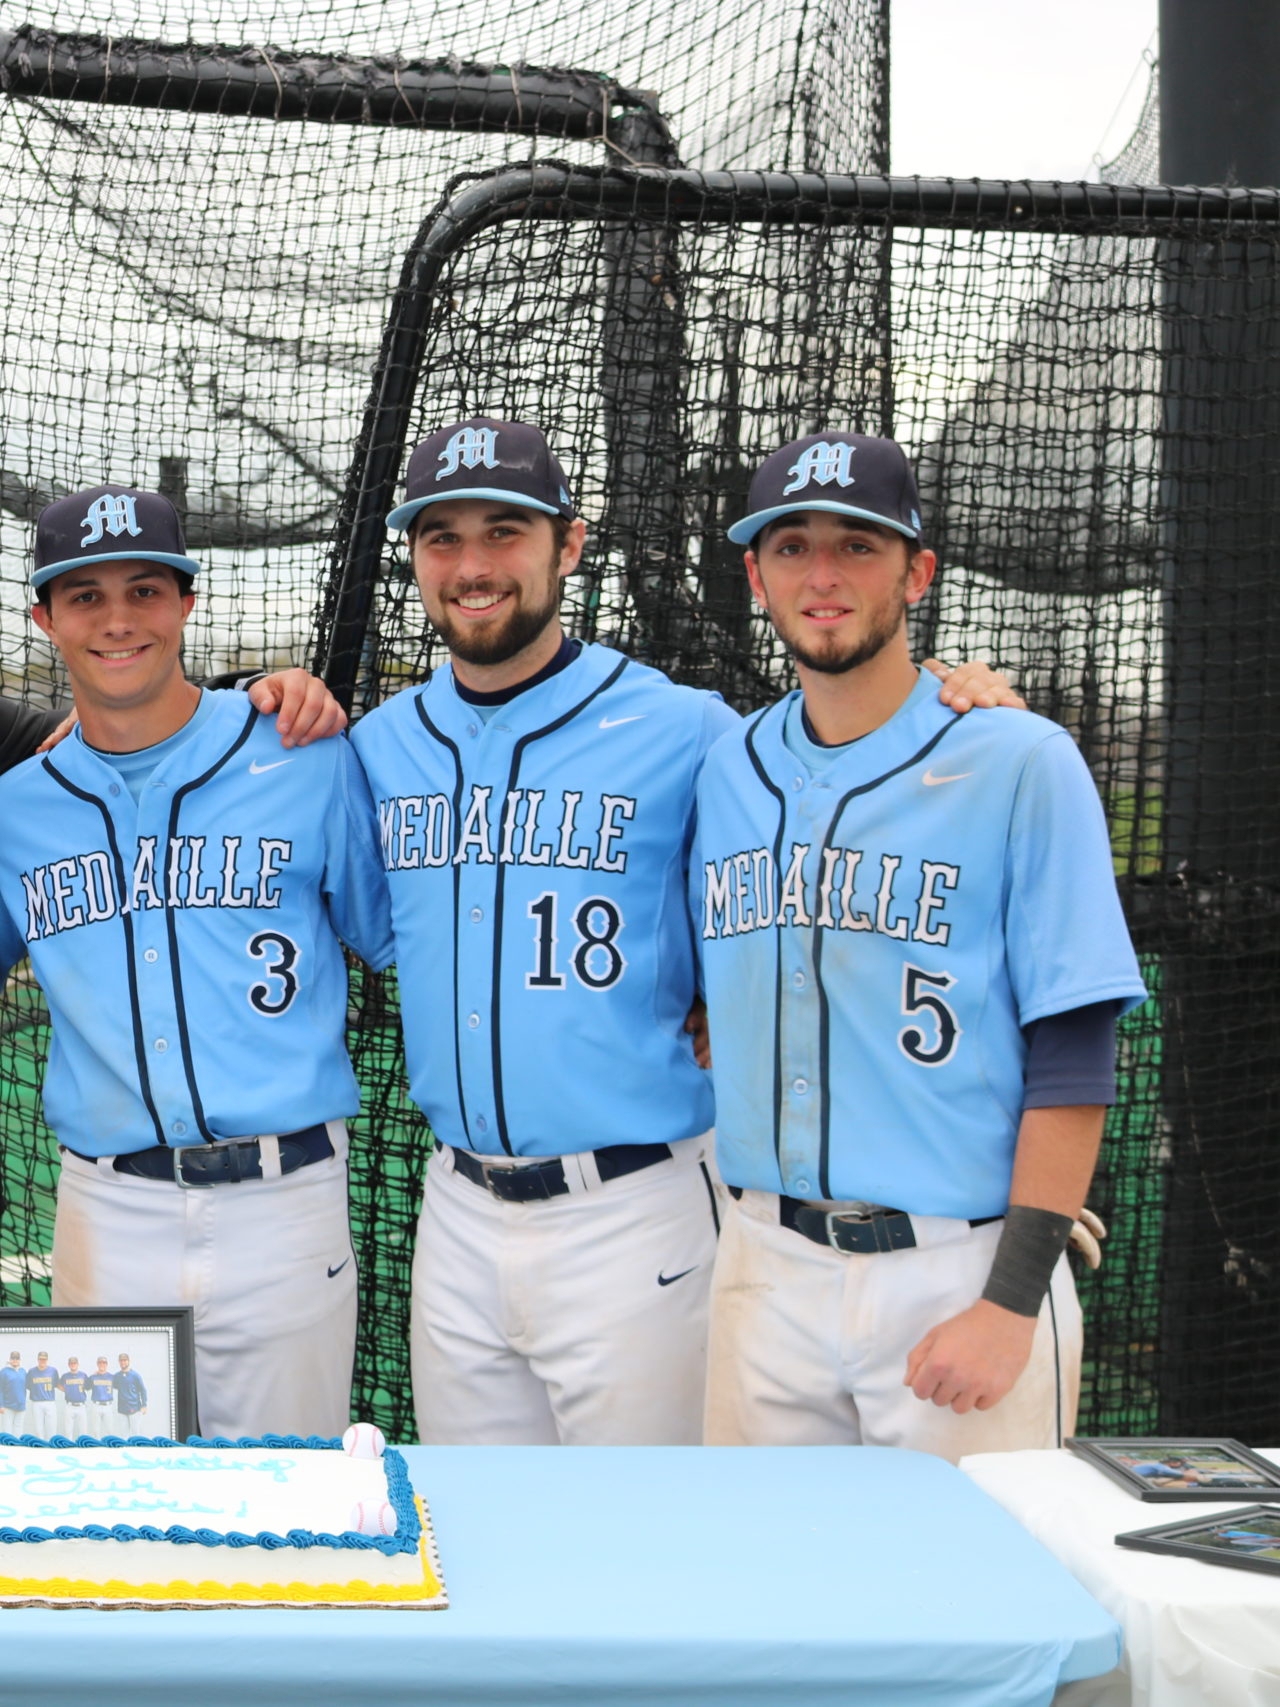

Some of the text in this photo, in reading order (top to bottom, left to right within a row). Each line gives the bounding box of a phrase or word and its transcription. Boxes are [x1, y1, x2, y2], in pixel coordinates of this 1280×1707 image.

[379, 784, 637, 874] MEDAILLE
[21, 835, 292, 943] MEDAILLE
[703, 842, 960, 947] MEDAILLE
[246, 929, 301, 1017] 3
[525, 891, 628, 992] 18
[897, 961, 963, 1068] 5
[21, 1473, 168, 1496] Our
